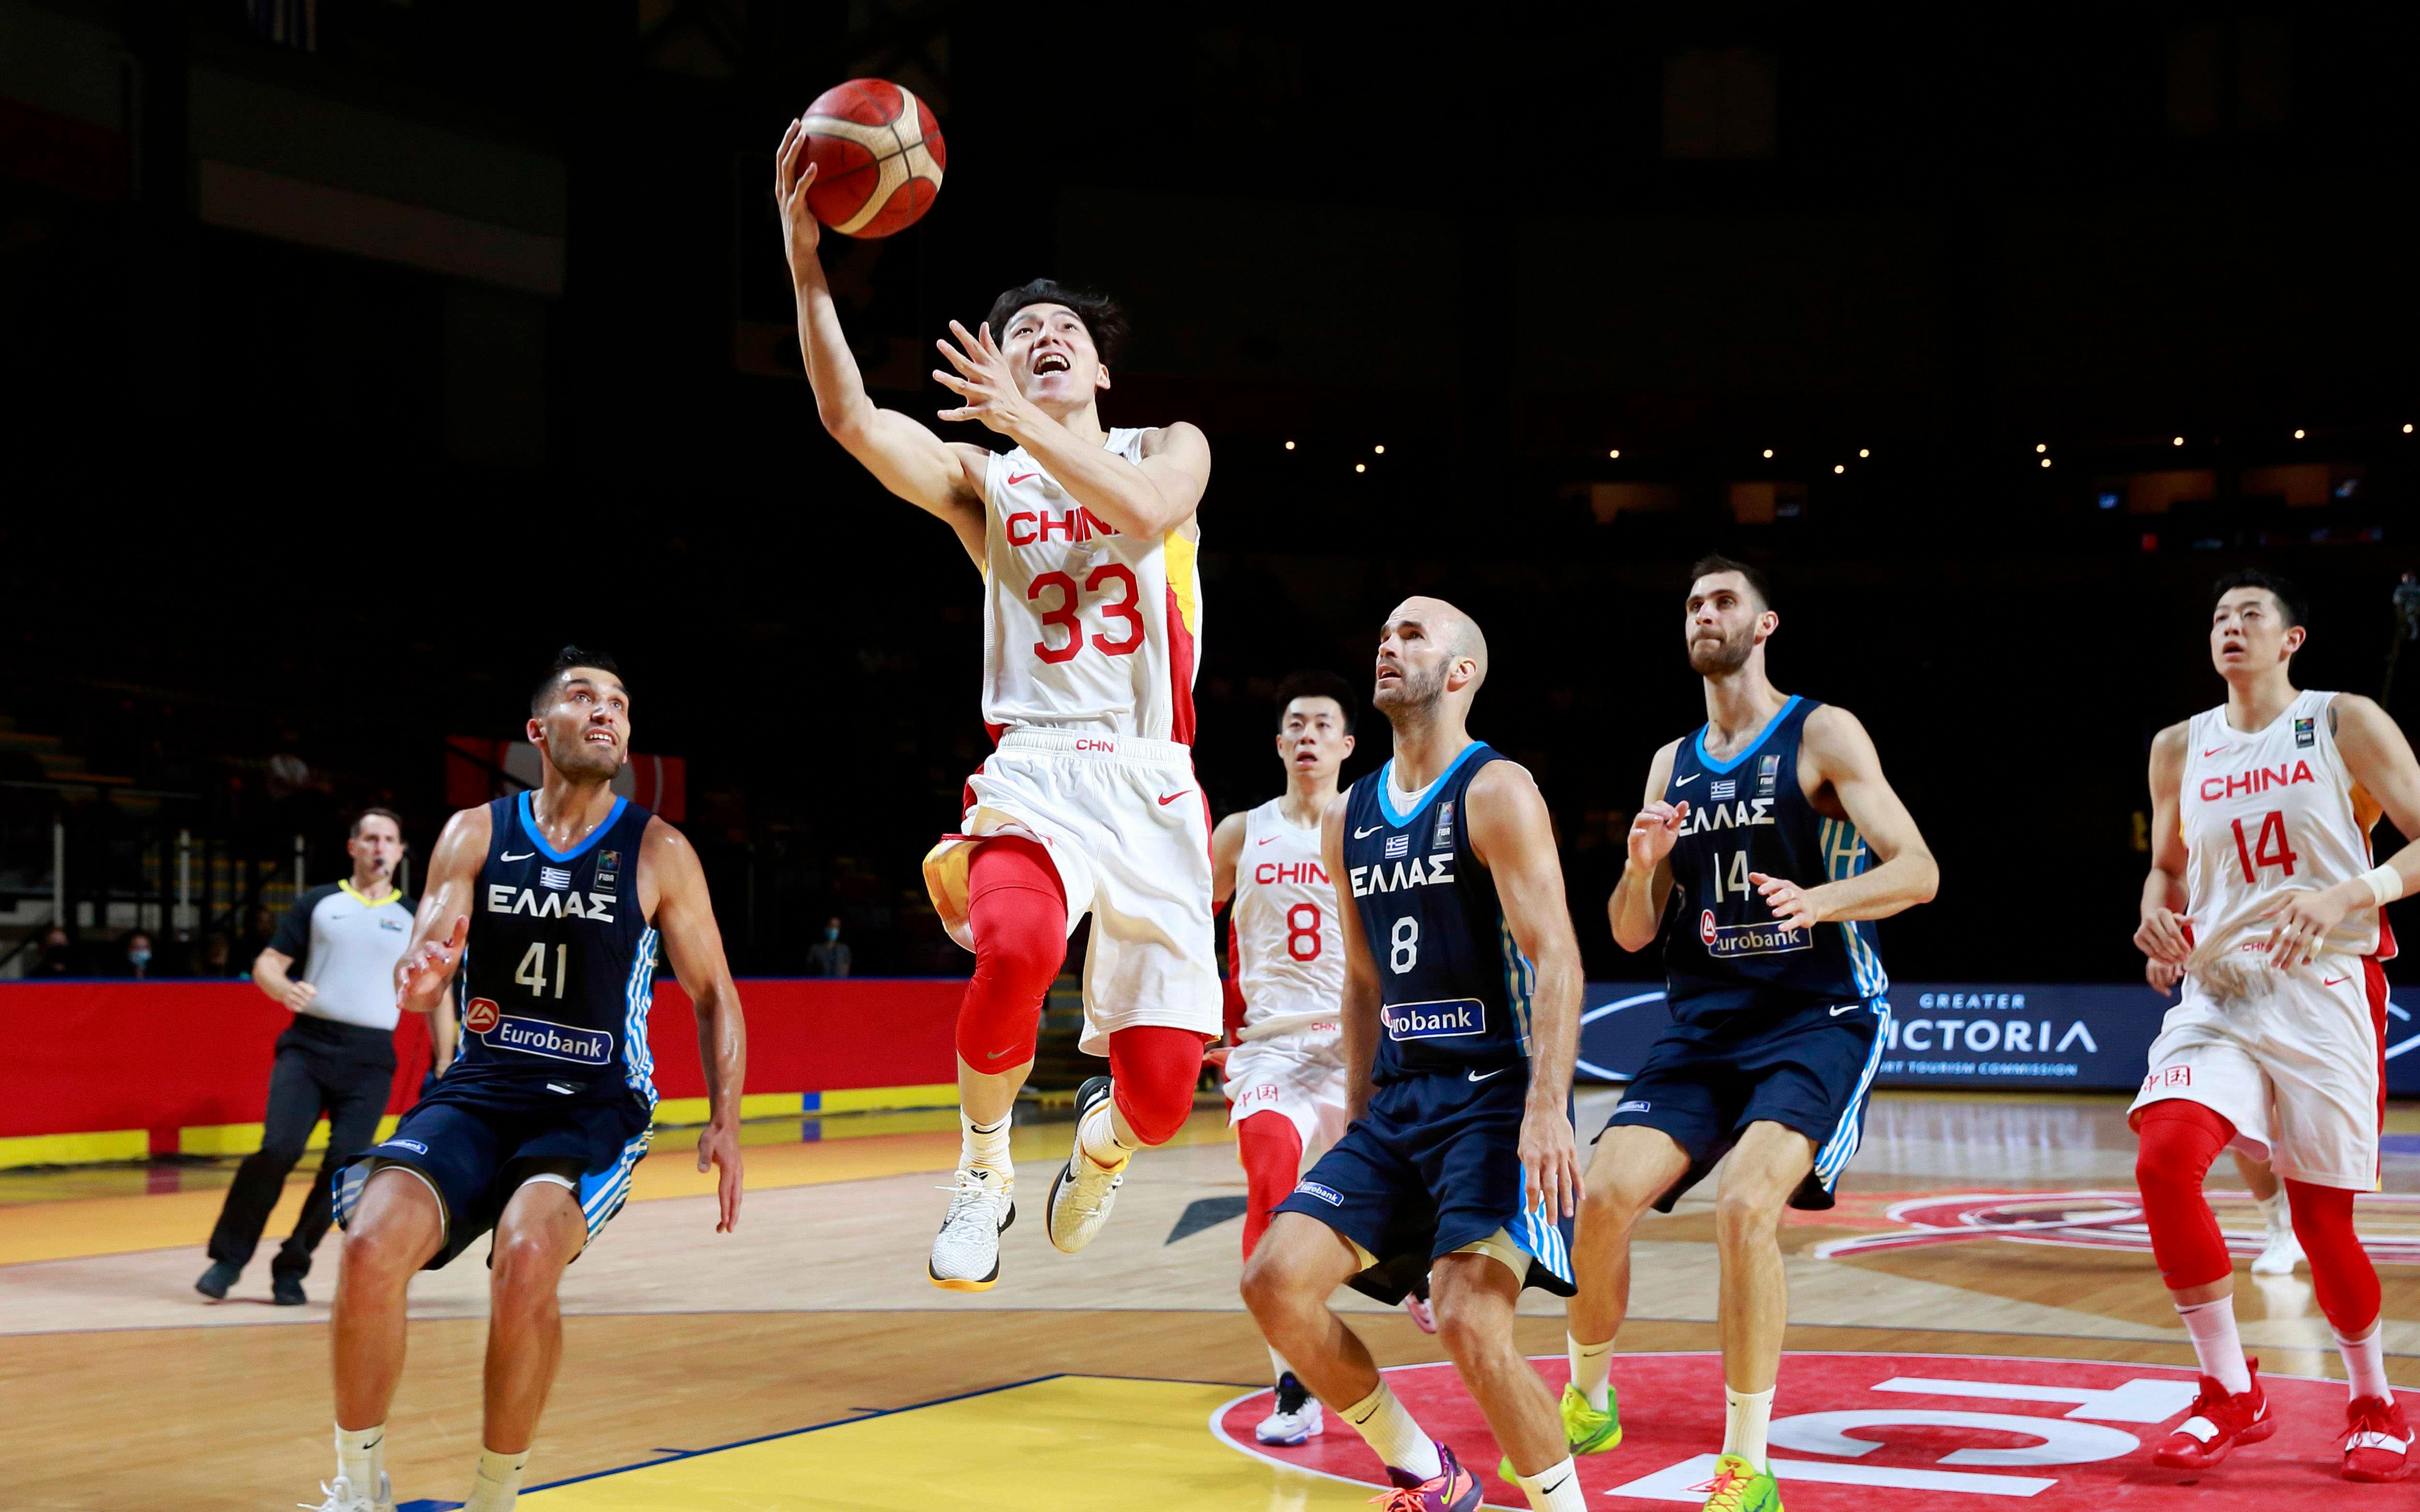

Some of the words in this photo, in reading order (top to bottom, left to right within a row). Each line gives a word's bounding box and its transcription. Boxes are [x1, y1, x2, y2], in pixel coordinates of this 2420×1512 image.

[1006, 506, 1120, 546] CHIN
[1028, 563, 1145, 664] 33
[1076, 739, 1114, 752] CHN
[2201, 760, 2315, 801] CHINA
[1437, 827, 1451, 837] FIBA
[2231, 810, 2297, 883] 14
[1255, 863, 1330, 884] CHIN
[1714, 851, 1750, 903] 14
[1287, 903, 1322, 961] 8
[1390, 916, 1419, 974] 8
[515, 942, 567, 1000] 41
[1919, 993, 2025, 1010] GREATER
[500, 1023, 602, 1057] Eurobank
[1887, 1018, 2098, 1053] ICTORIA
[1907, 1061, 1976, 1075] TOURISM
[1978, 1062, 2078, 1076] COMMISSION
